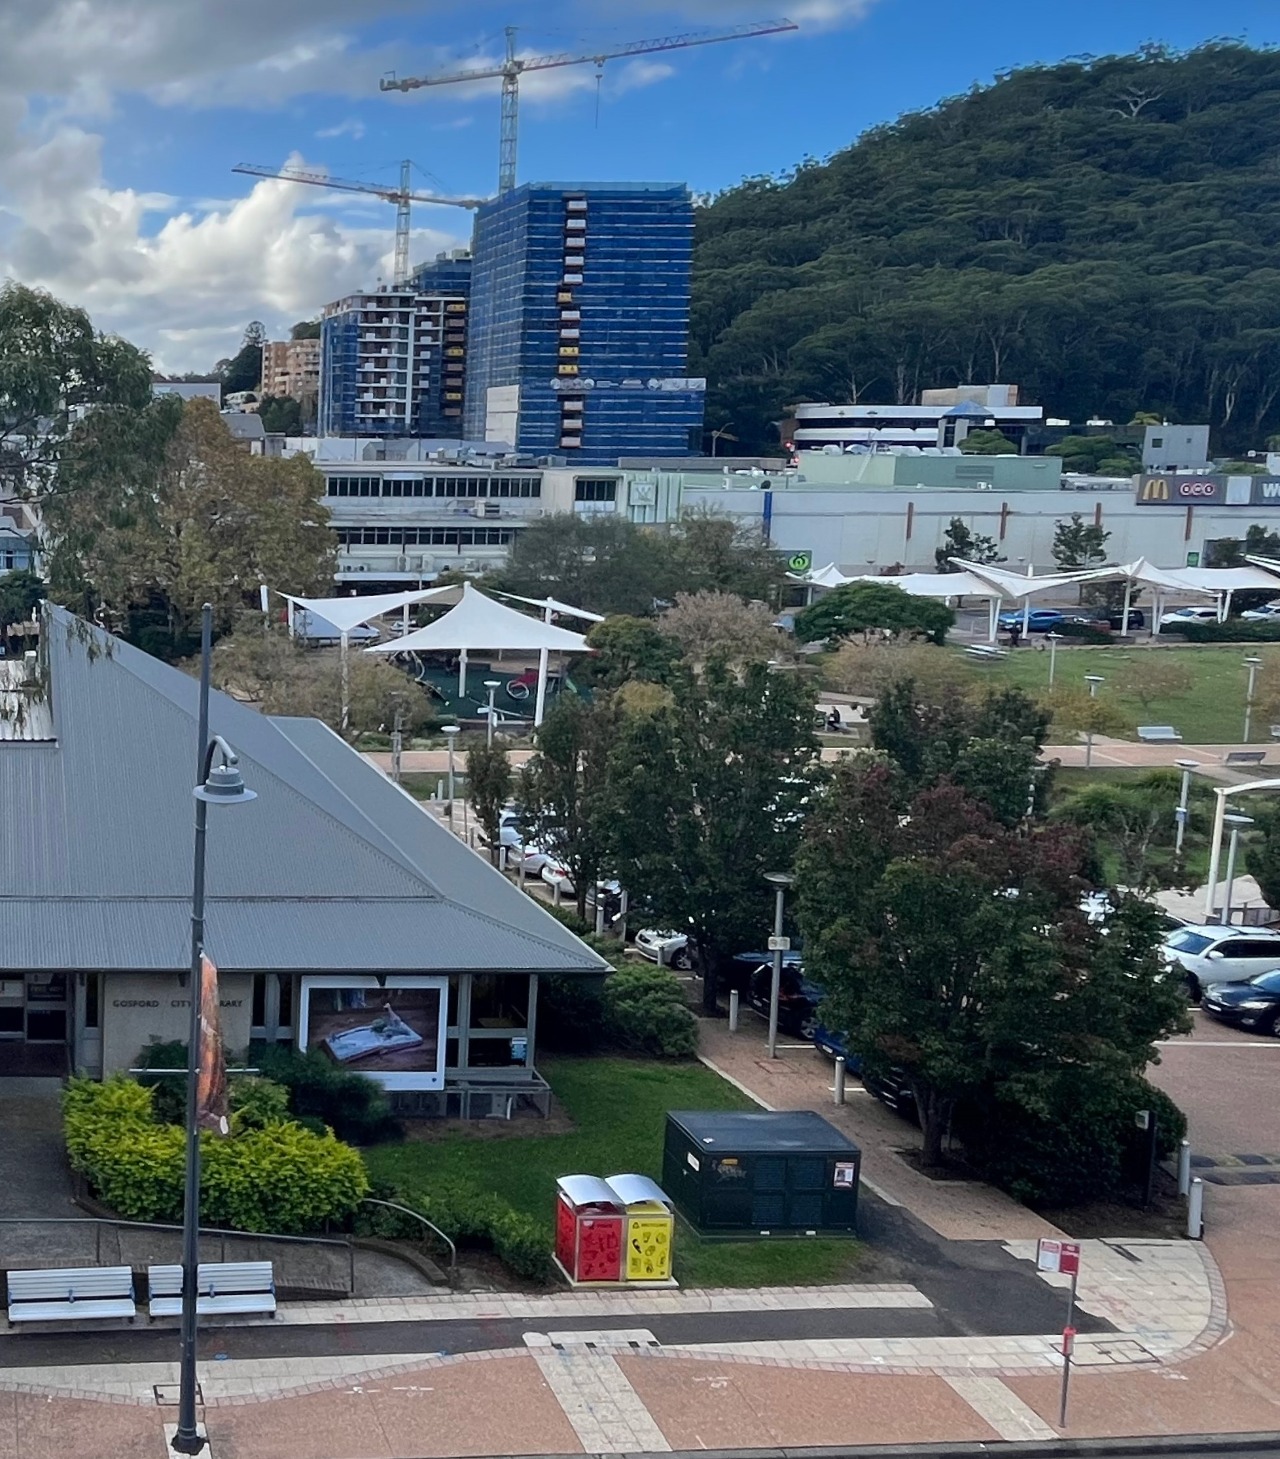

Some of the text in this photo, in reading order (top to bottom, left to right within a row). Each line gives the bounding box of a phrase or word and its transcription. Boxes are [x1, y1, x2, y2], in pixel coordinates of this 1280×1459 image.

[1262, 483, 1280, 498] W
[113, 1000, 159, 1008] GOSFORD
[219, 1000, 243, 1008] RARY
